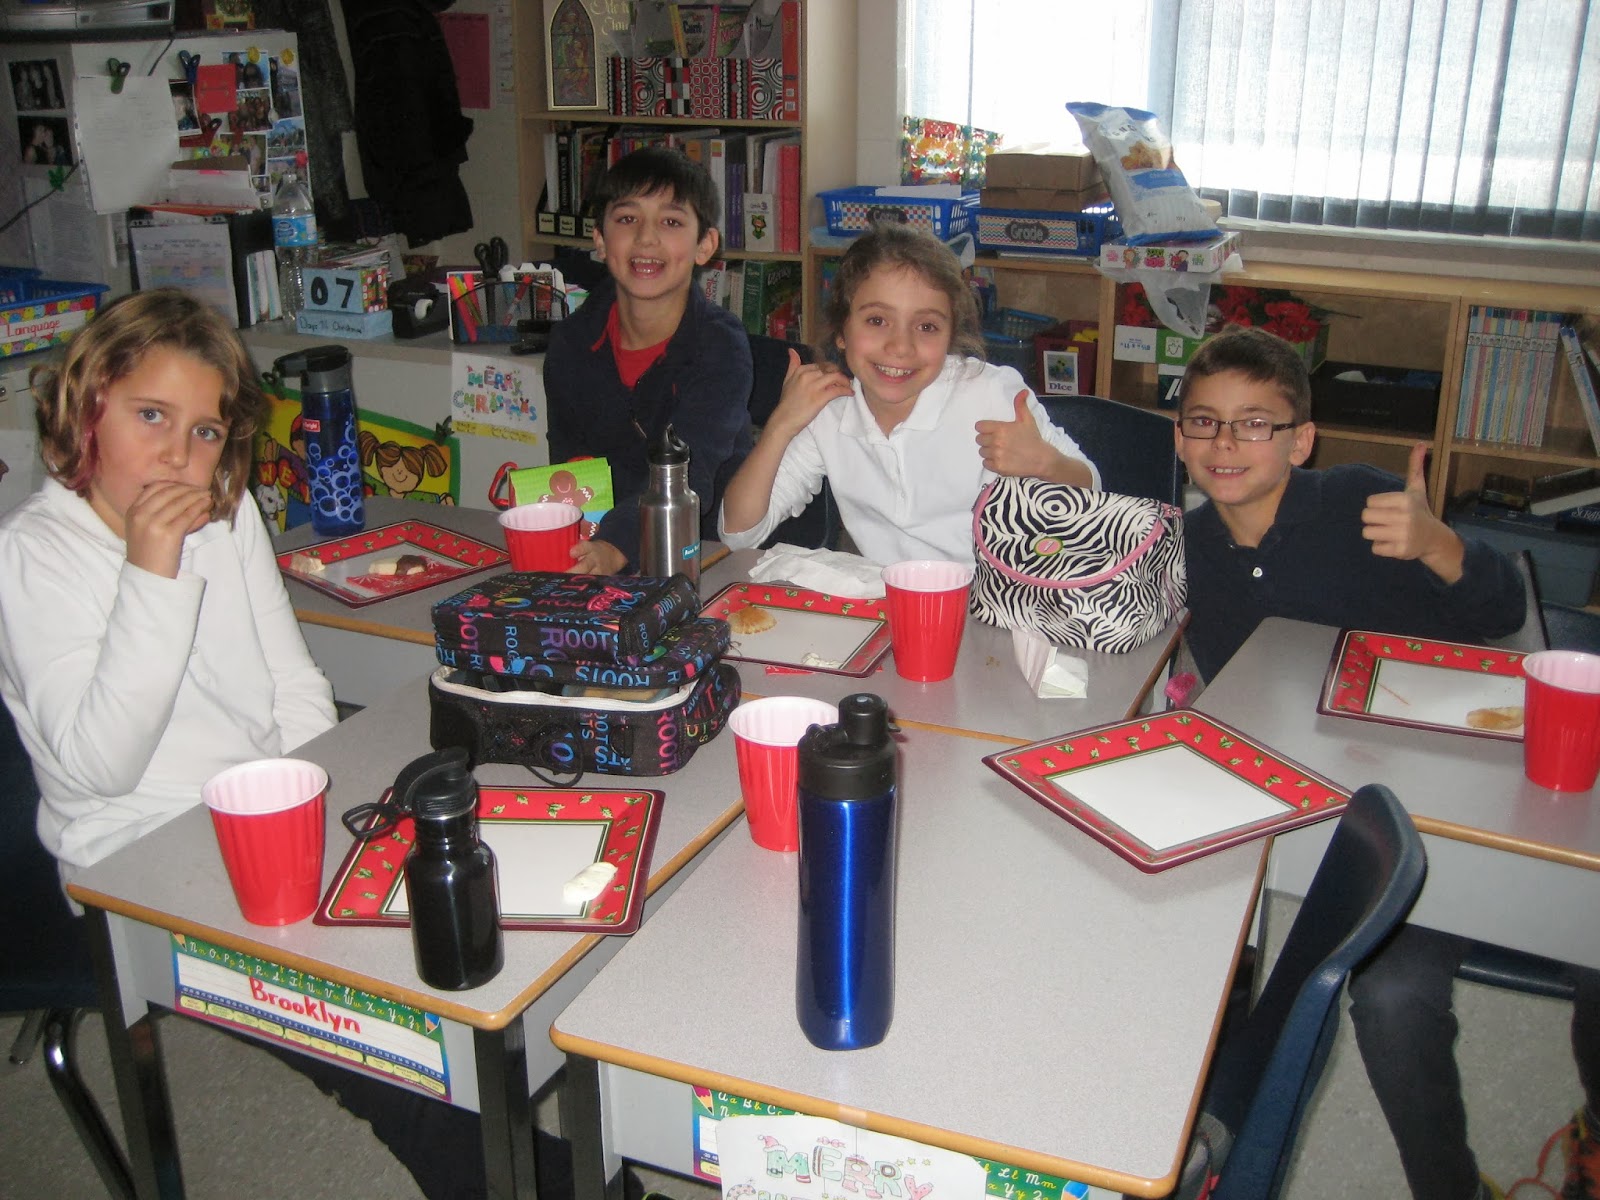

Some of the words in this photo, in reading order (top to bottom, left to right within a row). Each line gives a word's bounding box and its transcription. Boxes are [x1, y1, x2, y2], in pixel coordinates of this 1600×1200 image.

[1010, 227, 1043, 242] Grade
[311, 276, 354, 309] 07
[6, 320, 60, 338] Language
[467, 367, 523, 396] MERRY
[453, 390, 538, 421] CHRISTMAS
[656, 711, 680, 776] ROOT
[248, 975, 362, 1034] Brooklyn
[766, 1145, 934, 1200] MERRY
